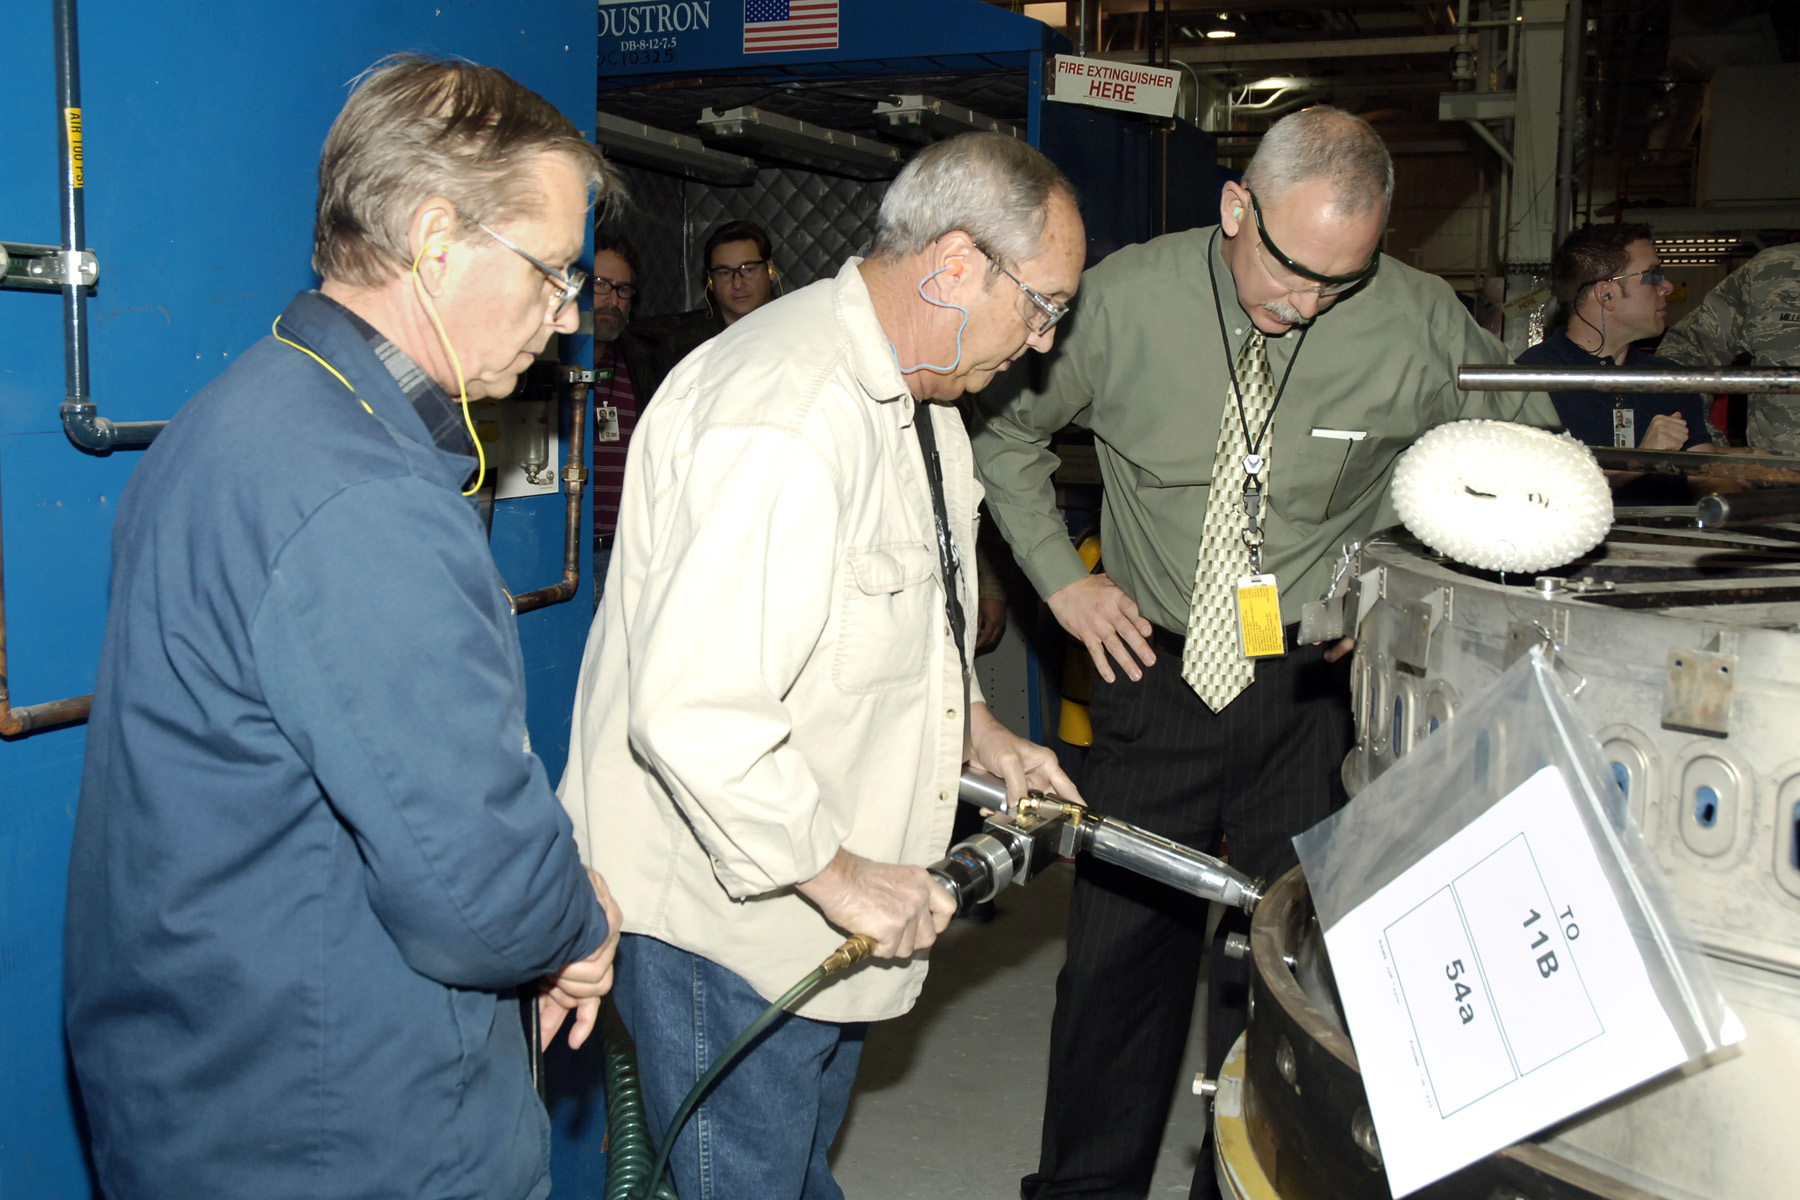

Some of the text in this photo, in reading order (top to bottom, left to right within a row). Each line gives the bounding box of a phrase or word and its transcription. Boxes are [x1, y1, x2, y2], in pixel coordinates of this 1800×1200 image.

[620, 37, 677, 51] DB-8-12-7.5
[1058, 61, 1173, 88] FIRE EXTINGUISHER
[1089, 80, 1137, 102] HERE
[70, 112, 82, 133] AIR
[1560, 904, 1580, 941] TO
[1522, 908, 1560, 979] 11B
[1445, 958, 1475, 1025] 54a
